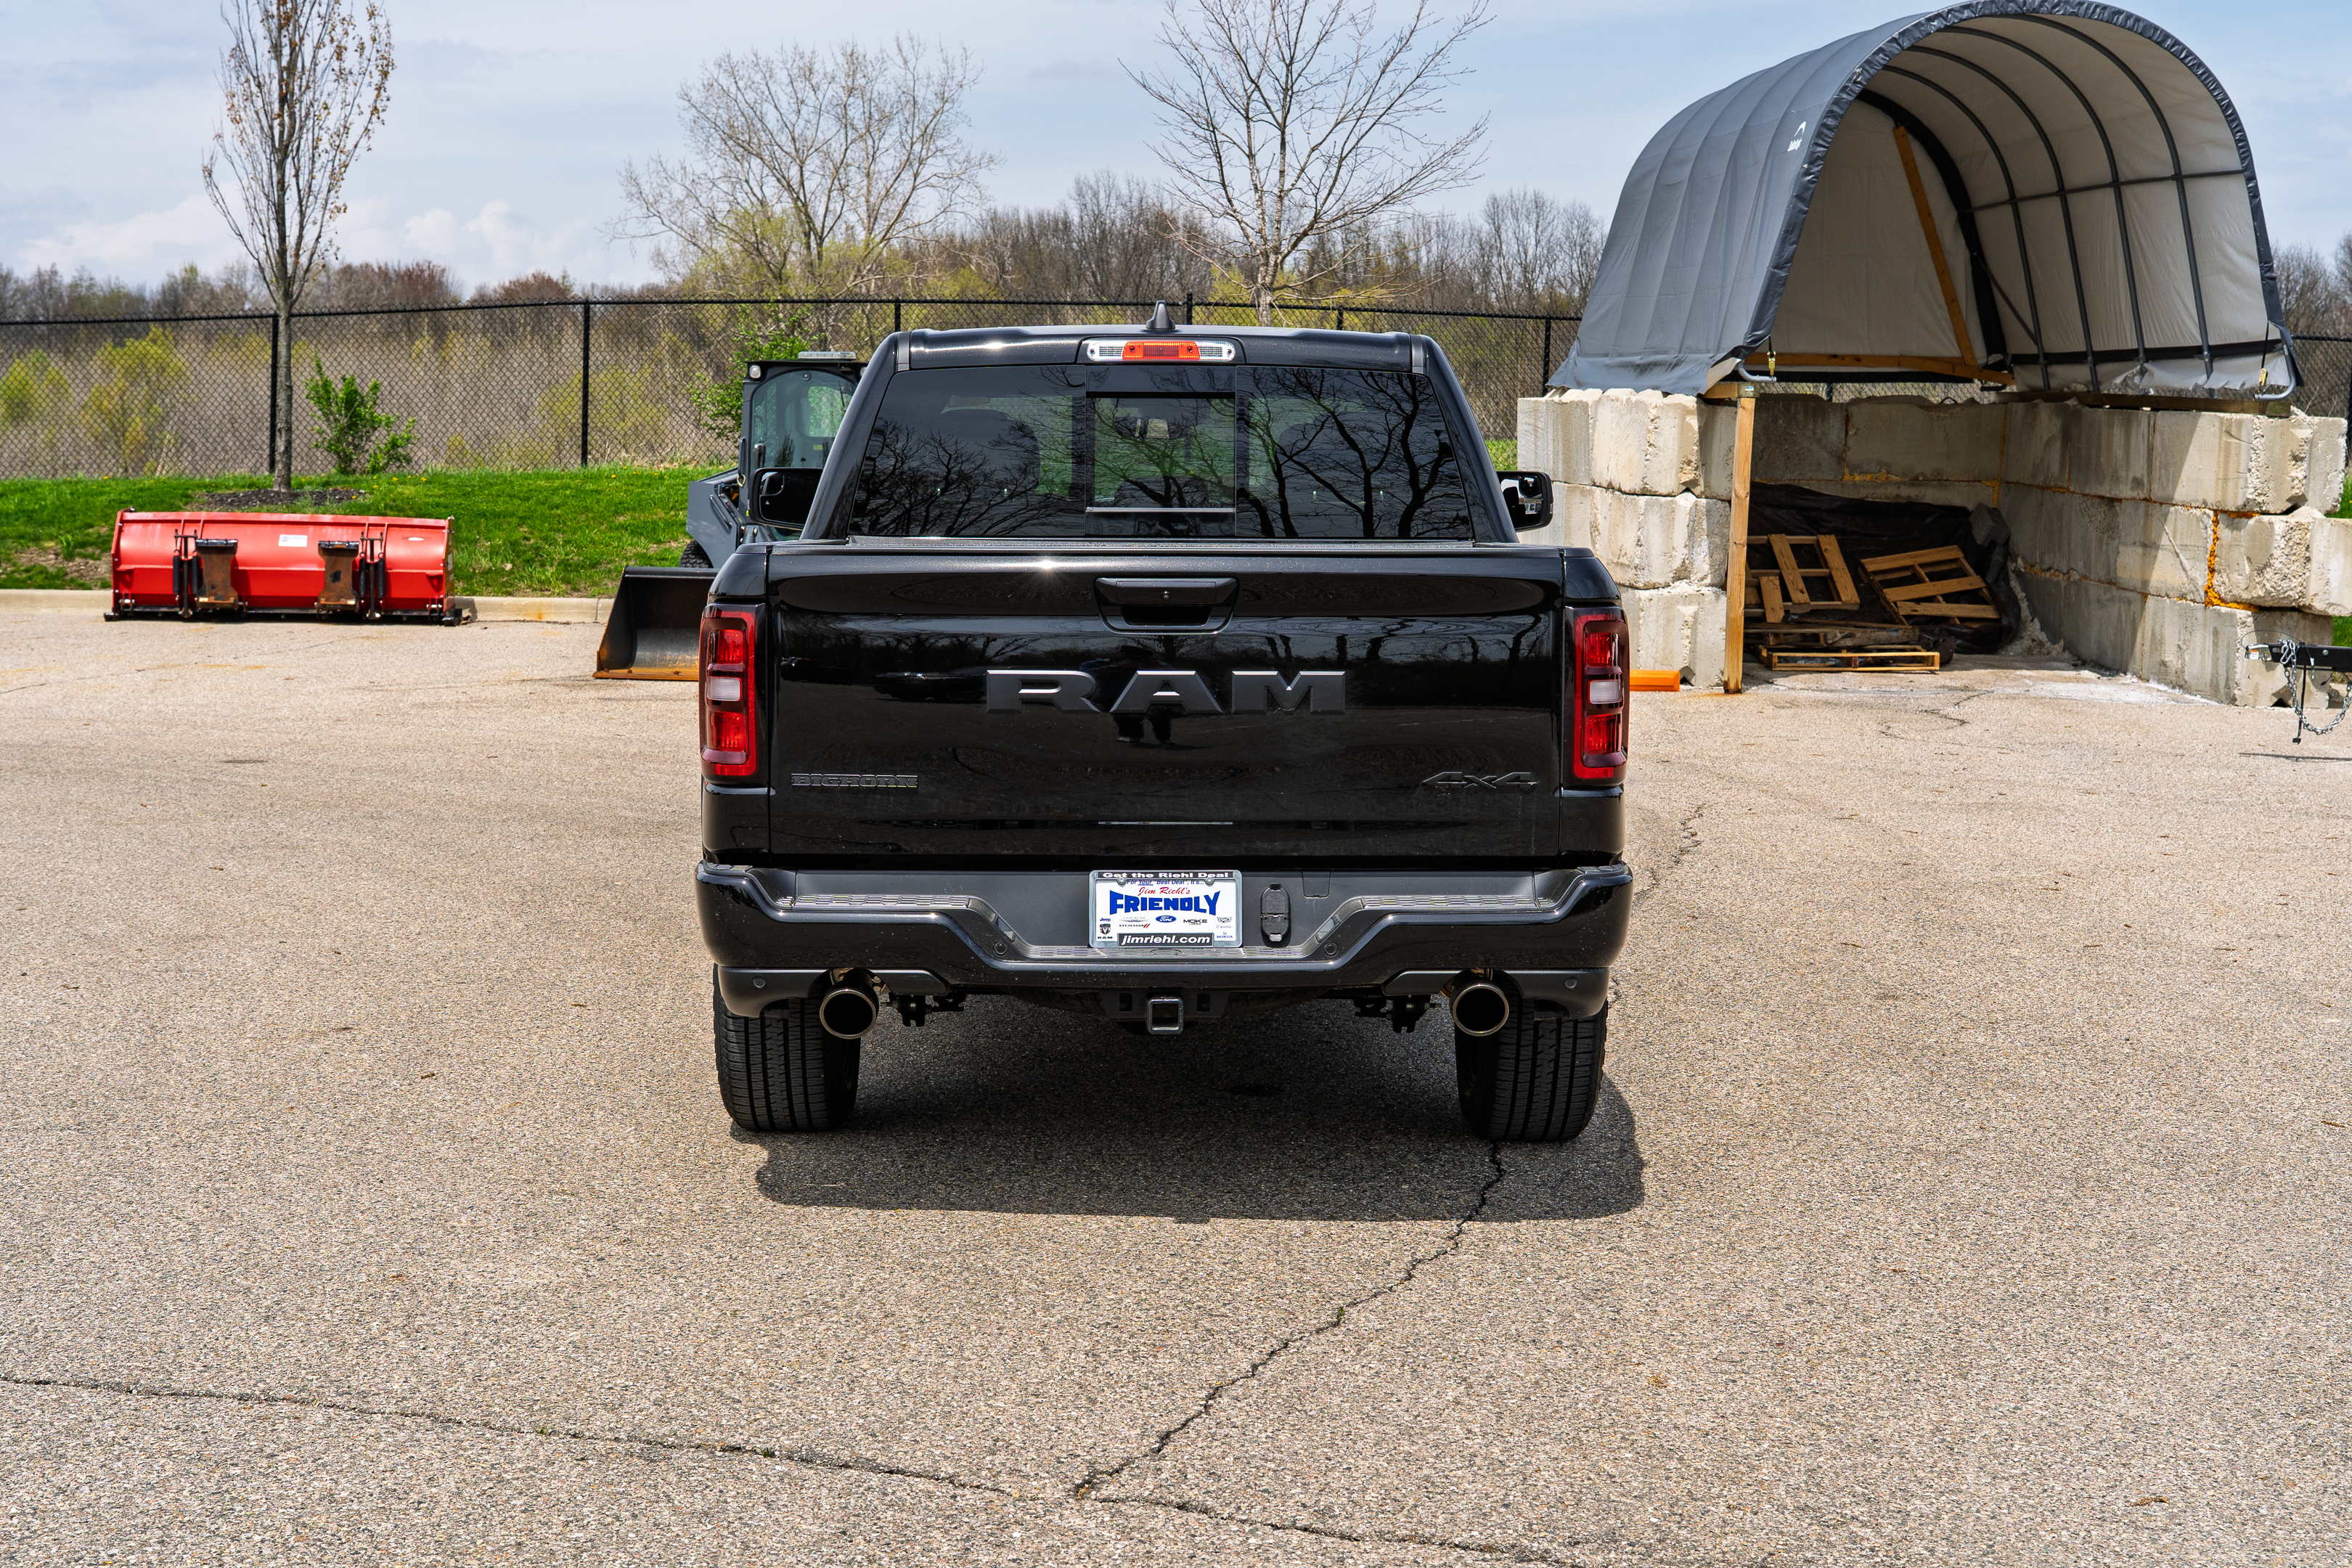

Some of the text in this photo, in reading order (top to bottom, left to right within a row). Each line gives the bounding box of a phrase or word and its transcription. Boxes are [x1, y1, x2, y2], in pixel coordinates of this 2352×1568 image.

[987, 669, 1346, 715] RAM
[791, 773, 918, 788] BIGHORN
[1421, 771, 1539, 790] 4x4
[1138, 886, 1156, 897] Jim
[1109, 890, 1220, 915] FRIENDLY
[1121, 935, 1210, 945] jimriehl.com
